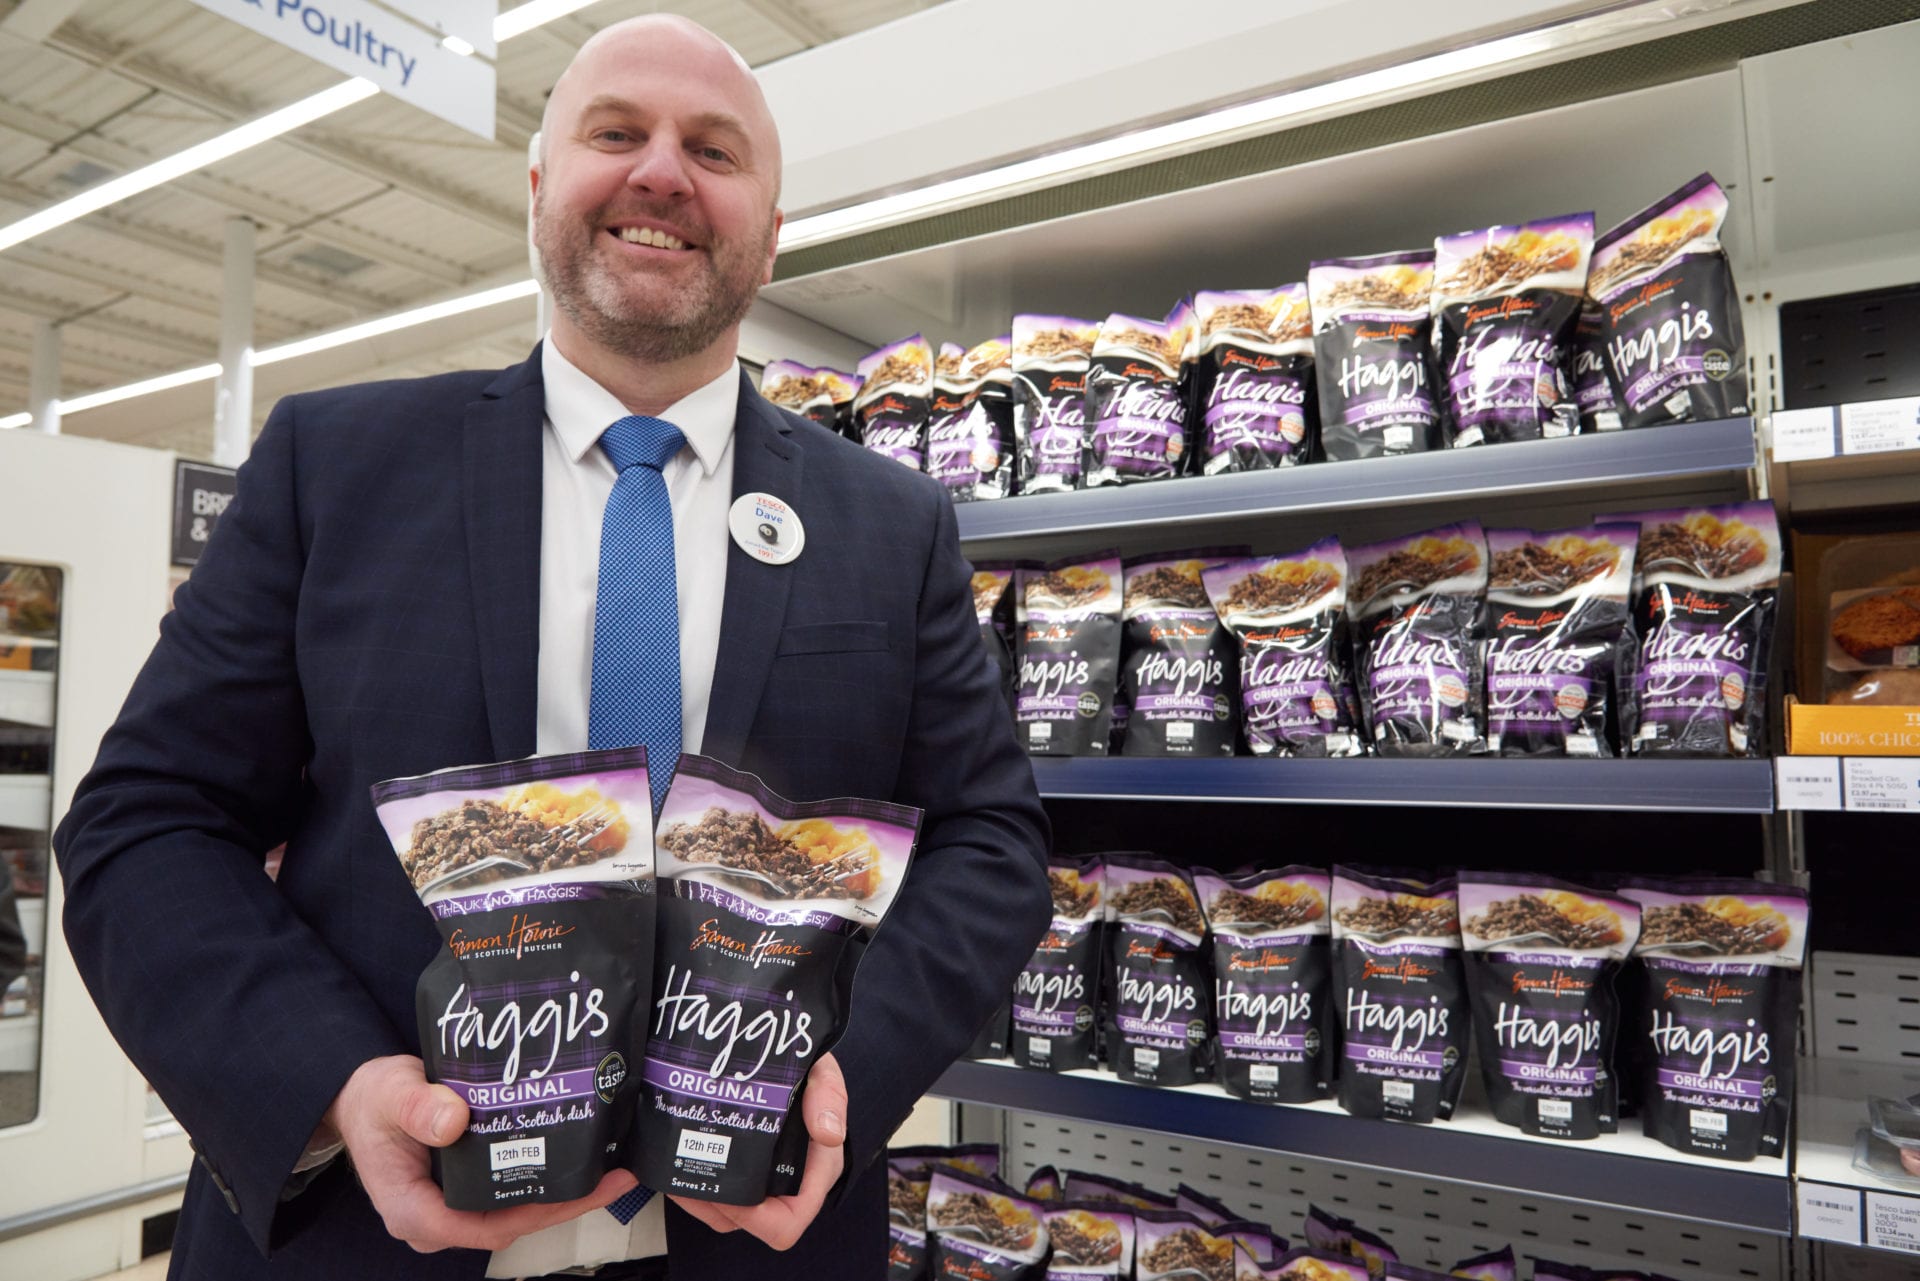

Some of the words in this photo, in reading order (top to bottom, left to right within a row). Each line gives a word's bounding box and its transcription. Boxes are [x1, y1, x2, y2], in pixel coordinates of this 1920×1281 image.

[1608, 302, 1713, 382] Haggis
[1636, 359, 1691, 394] ORIGINAL
[1366, 400, 1424, 416] ORIGINAL
[757, 496, 785, 511] TESCO
[755, 507, 783, 524] Dave
[758, 549, 774, 559] 1991
[1136, 649, 1223, 697] Haggis
[1649, 661, 1720, 674] ORIGINAL
[1495, 677, 1554, 688] ORIGINAL
[1253, 685, 1308, 700] ORIGINAL
[1154, 697, 1206, 707] ORIGINAL
[1819, 731, 1865, 746] 100%
[449, 928, 503, 958] Simon
[507, 914, 576, 960] Howie
[690, 918, 746, 951] Simon
[749, 930, 812, 969] Howie
[475, 948, 516, 959] SCOTTISH
[524, 942, 562, 952] BUTCHER
[706, 943, 717, 951] THE
[720, 947, 755, 963] SCOTTISH
[762, 956, 796, 967] BUTCHER
[1117, 965, 1196, 1023] Haggis
[1216, 978, 1311, 1037] Haggis
[437, 970, 609, 1085] Haggis
[656, 964, 813, 1081] Haggis
[1124, 1020, 1174, 1034] ORIGINAL
[1347, 987, 1449, 1053] Haggis
[1234, 1035, 1291, 1048] ORIGINAL
[1494, 1002, 1601, 1069] Haggis
[1649, 1008, 1770, 1080] Haggis
[1367, 1048, 1429, 1064] ORIGINAL
[597, 1070, 626, 1089] taste
[1520, 1064, 1588, 1081] ORIGINAL
[468, 1078, 571, 1105] ORIGINAL
[668, 1070, 768, 1104] ORIGINAL
[1673, 1073, 1746, 1093] ORIGINAL
[515, 1105, 566, 1129] Scottish
[567, 1101, 595, 1120] dish
[666, 1104, 708, 1121] versatile
[708, 1110, 757, 1130] Scottish
[756, 1114, 780, 1134] dish
[496, 1148, 519, 1161] 12th
[521, 1146, 540, 1158] FEB
[684, 1138, 705, 1152] 12th
[706, 1141, 725, 1155] FEB
[775, 1163, 795, 1176] 454g
[495, 1189, 525, 1200] Serves
[526, 1185, 533, 1194] 2
[539, 1185, 545, 1194] 3
[671, 1177, 699, 1190] Serves
[700, 1182, 707, 1191] 2
[713, 1184, 720, 1193] 3
[1875, 1203, 1898, 1213] Tesco
[1874, 1211, 1889, 1220] Leg
[1891, 1213, 1918, 1224] Steaks
